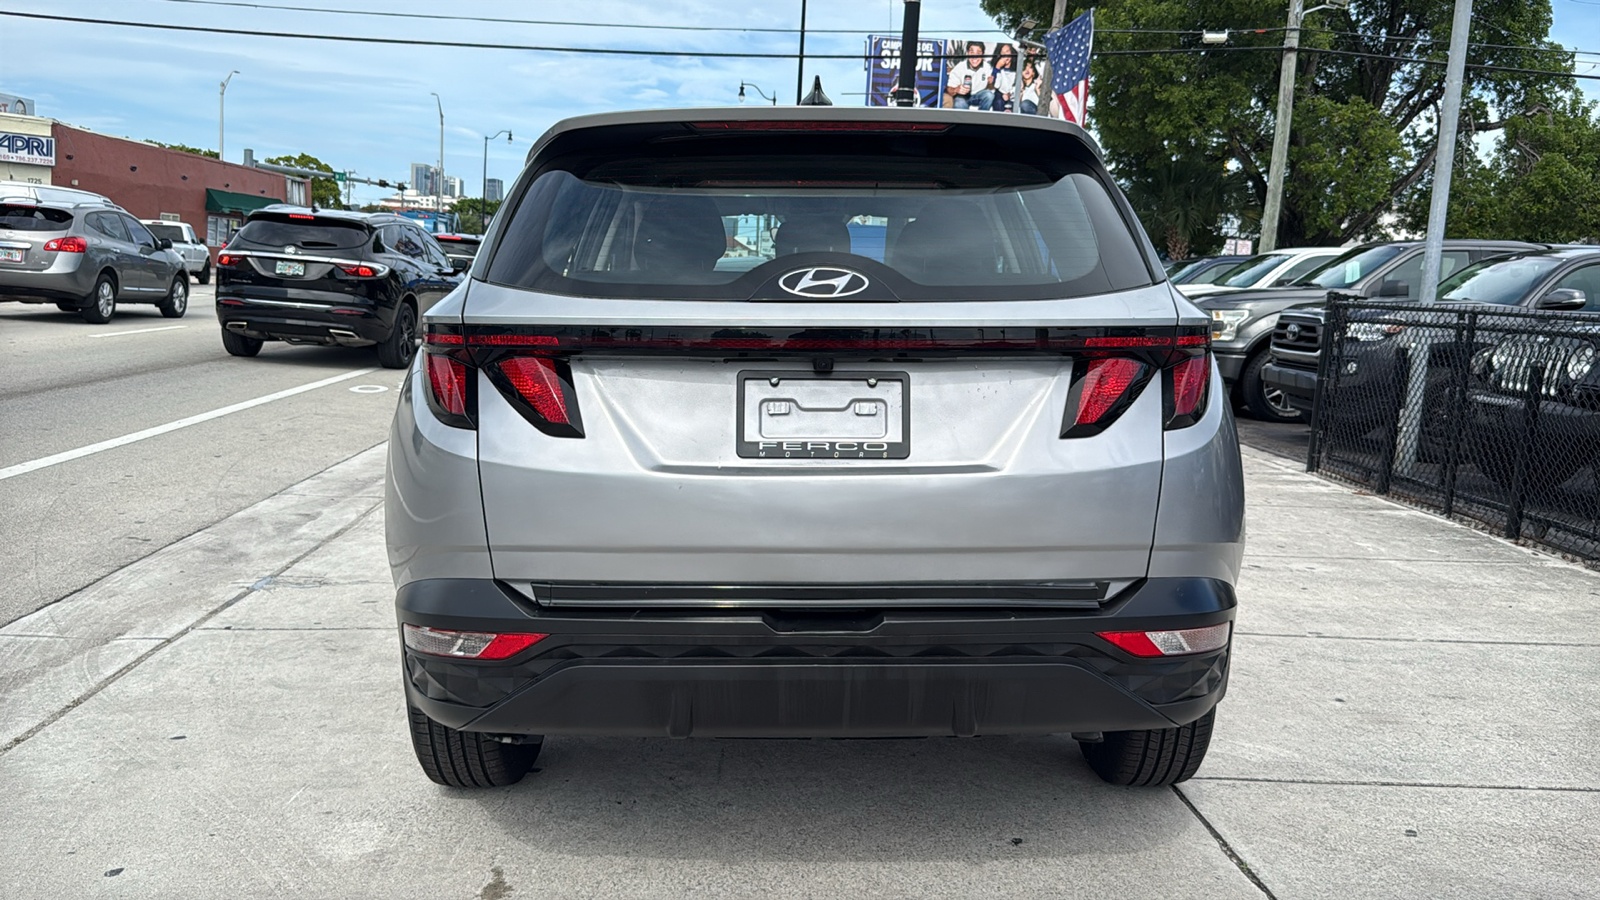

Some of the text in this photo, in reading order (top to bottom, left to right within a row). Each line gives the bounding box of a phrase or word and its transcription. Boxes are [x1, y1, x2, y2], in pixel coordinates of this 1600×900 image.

[881, 40, 934, 52] CAMPS DEL
[880, 50, 934, 71] SAR
[0, 135, 53, 157] APRI
[759, 441, 888, 451] FERCO
